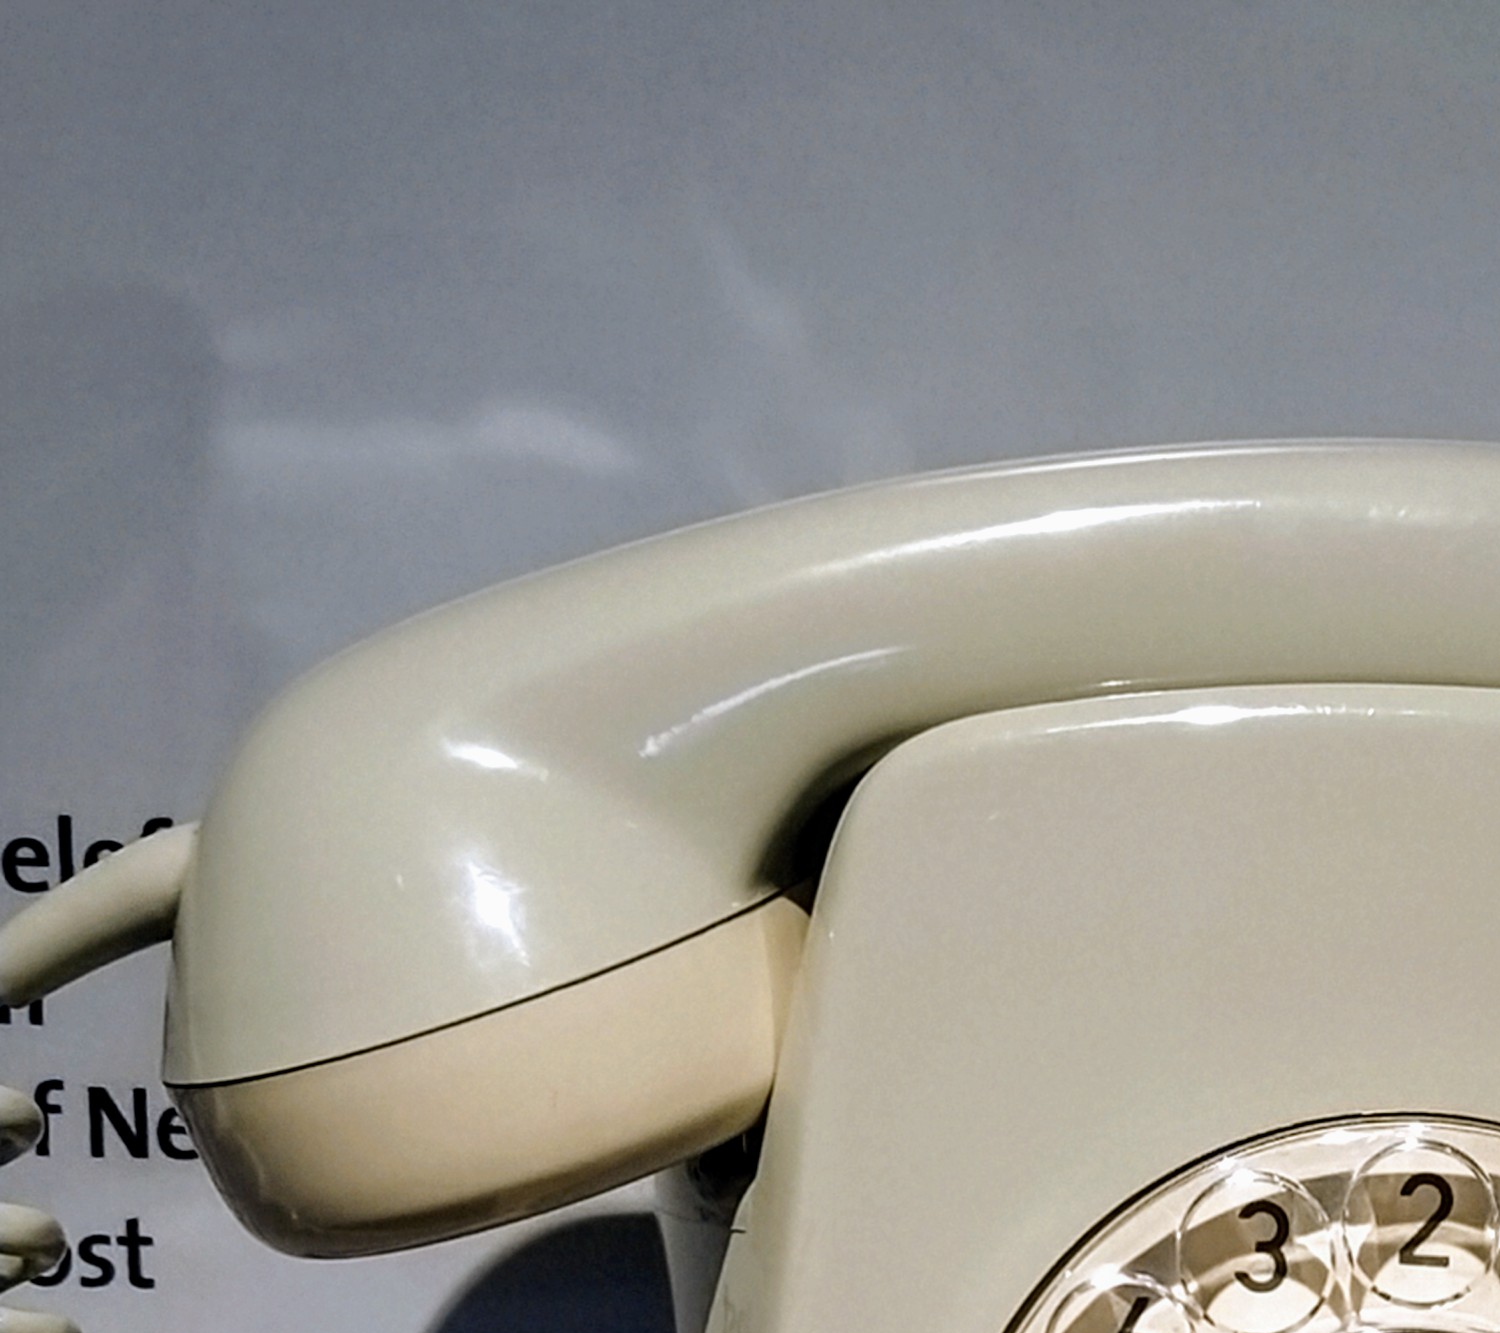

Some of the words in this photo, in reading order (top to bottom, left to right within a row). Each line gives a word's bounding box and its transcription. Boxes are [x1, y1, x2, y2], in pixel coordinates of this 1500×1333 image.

[1, 814, 174, 894] el
[1235, 1200, 1290, 1293] 3
[1399, 1173, 1454, 1268] 2
